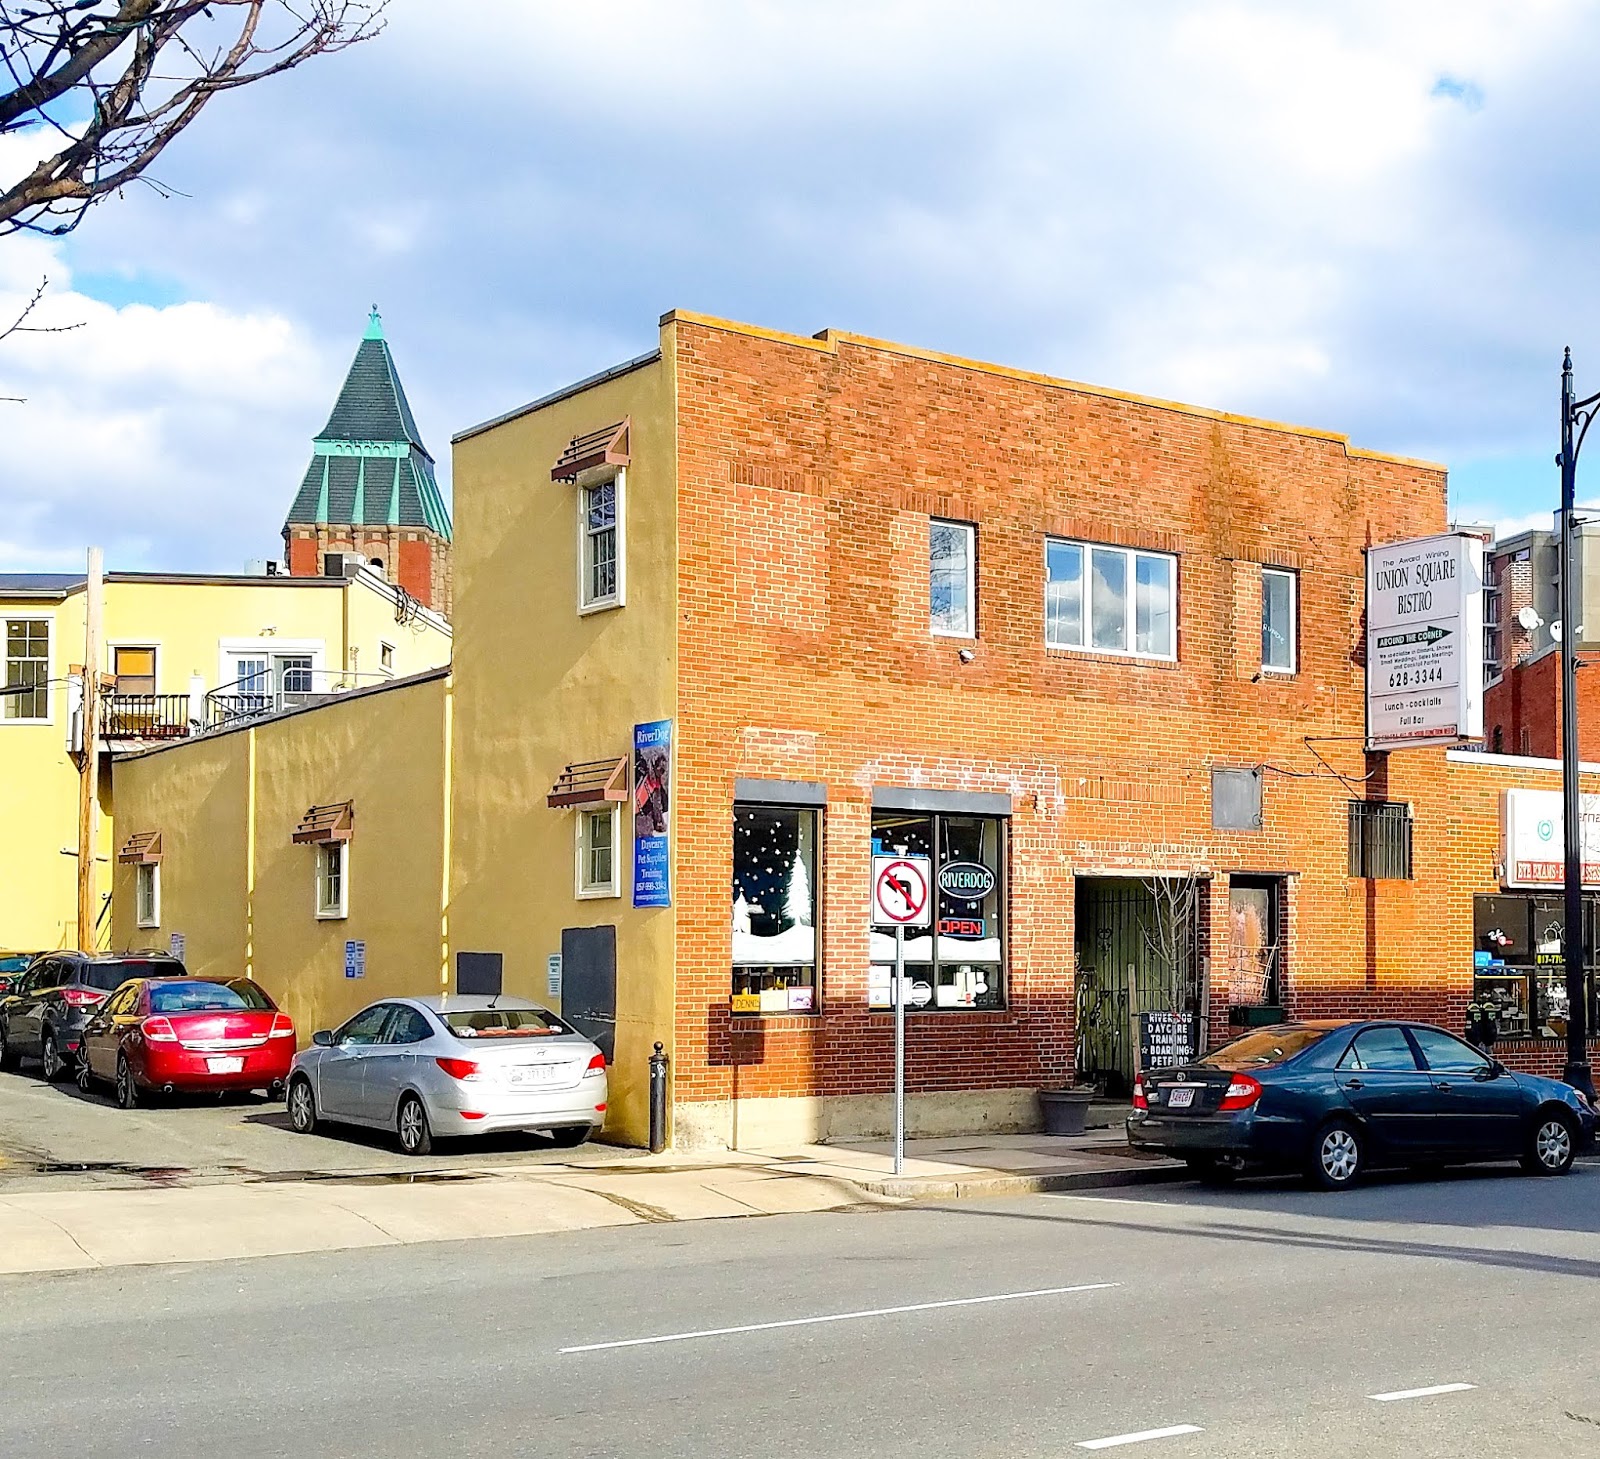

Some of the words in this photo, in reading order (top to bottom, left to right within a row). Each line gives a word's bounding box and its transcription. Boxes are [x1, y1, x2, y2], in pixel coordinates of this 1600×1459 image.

[1382, 560, 1395, 568] The
[1398, 554, 1421, 565] Award
[1425, 550, 1450, 559] Wining
[1376, 566, 1409, 591] UNION
[1416, 558, 1456, 587] SQUARE
[1397, 590, 1433, 615] BISTRO
[1379, 635, 1405, 647] AROUND
[1405, 633, 1418, 643] THE
[1417, 629, 1443, 642] CORNER
[1389, 666, 1442, 688] 628-3344
[1384, 701, 1404, 711] Lunch
[1399, 716, 1412, 726] Full
[1413, 715, 1425, 725] Bar
[636, 728, 670, 744] RiverDog
[641, 839, 664, 852] Daycare
[637, 854, 646, 864] Pet
[641, 867, 663, 880] Training
[1518, 862, 1531, 880] EYE
[1532, 862, 1556, 880] EXAMS
[941, 872, 991, 889] RIVERDOG
[938, 919, 982, 935] OPEN
[1149, 1013, 1173, 1023] RIVER
[1147, 1023, 1188, 1034] DAYCRE
[1150, 1034, 1188, 1045] TRAINNG
[1150, 1045, 1189, 1056] BOARING
[1151, 1055, 1189, 1067] PETFOD
